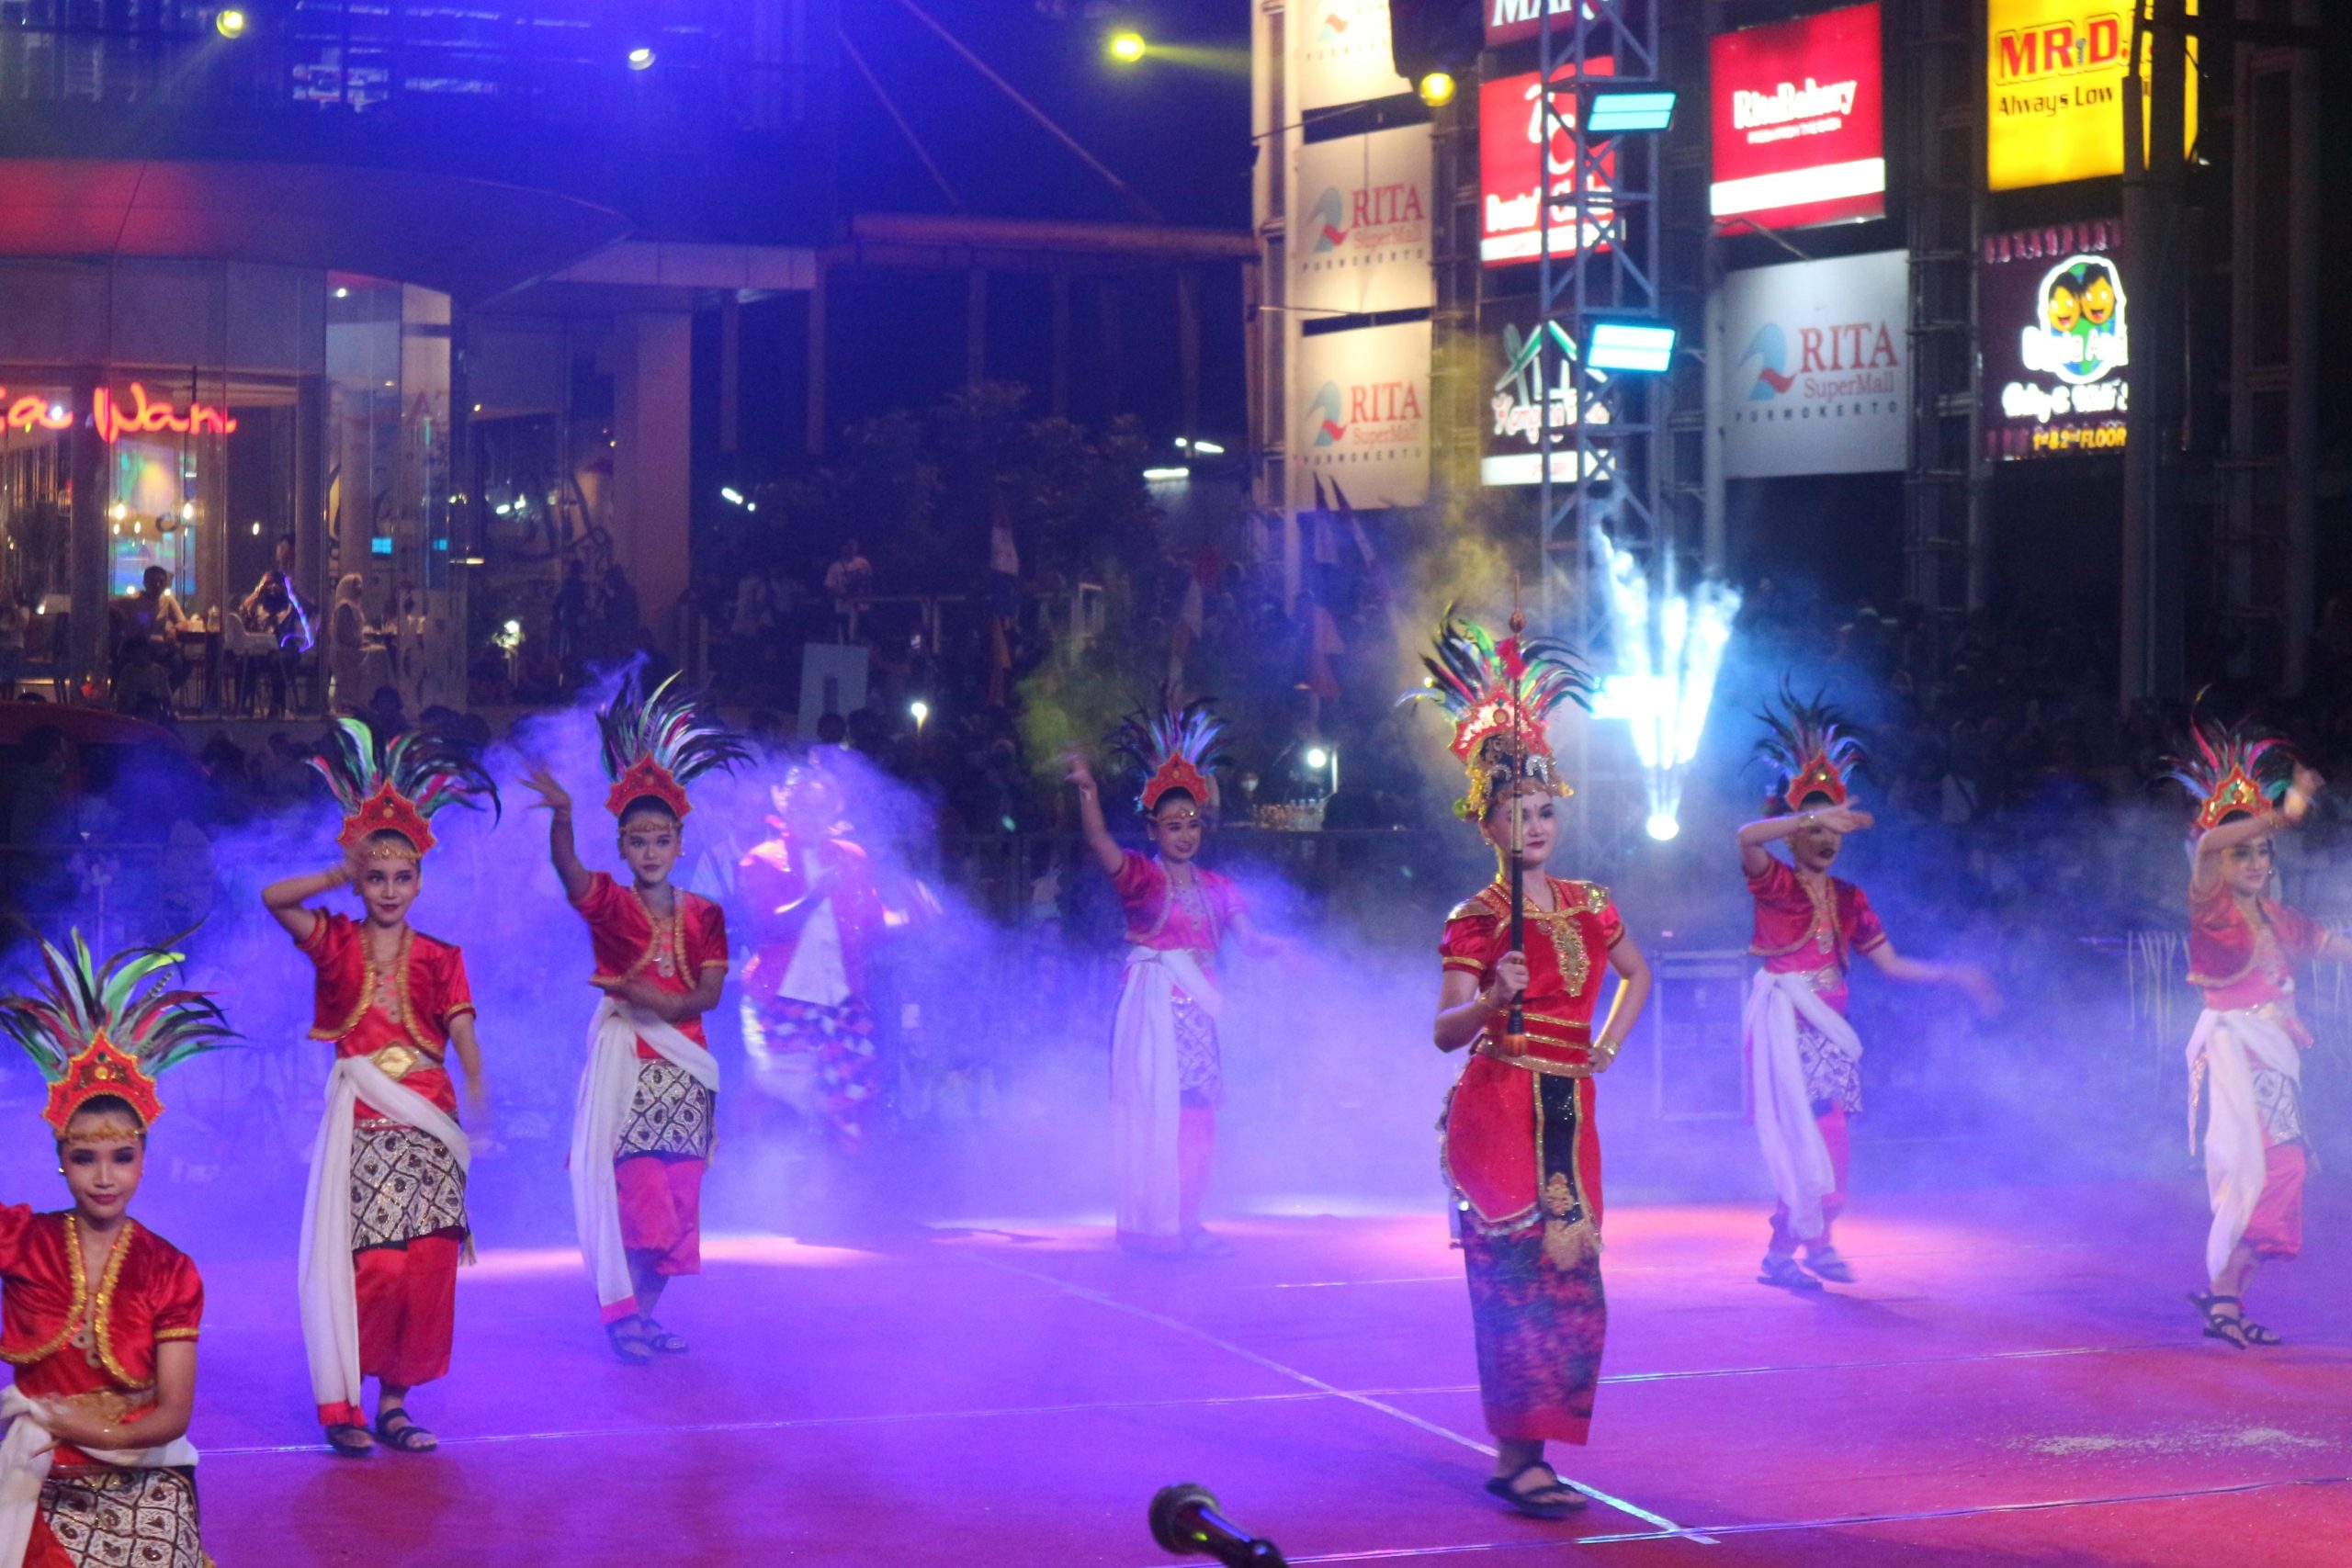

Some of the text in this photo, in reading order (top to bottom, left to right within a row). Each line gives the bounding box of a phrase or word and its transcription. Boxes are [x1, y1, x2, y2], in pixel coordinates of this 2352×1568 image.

[1998, 85, 2113, 117] Always Low
[1351, 182, 1425, 229] RITA
[1799, 320, 1899, 374] RITA
[1350, 381, 1422, 424] RITA
[1804, 371, 1894, 403] SuperMall
[1736, 400, 1898, 423] PURWOKERTO
[1352, 423, 1419, 449] SuperMall
[2079, 425, 2128, 449] FLOOR
